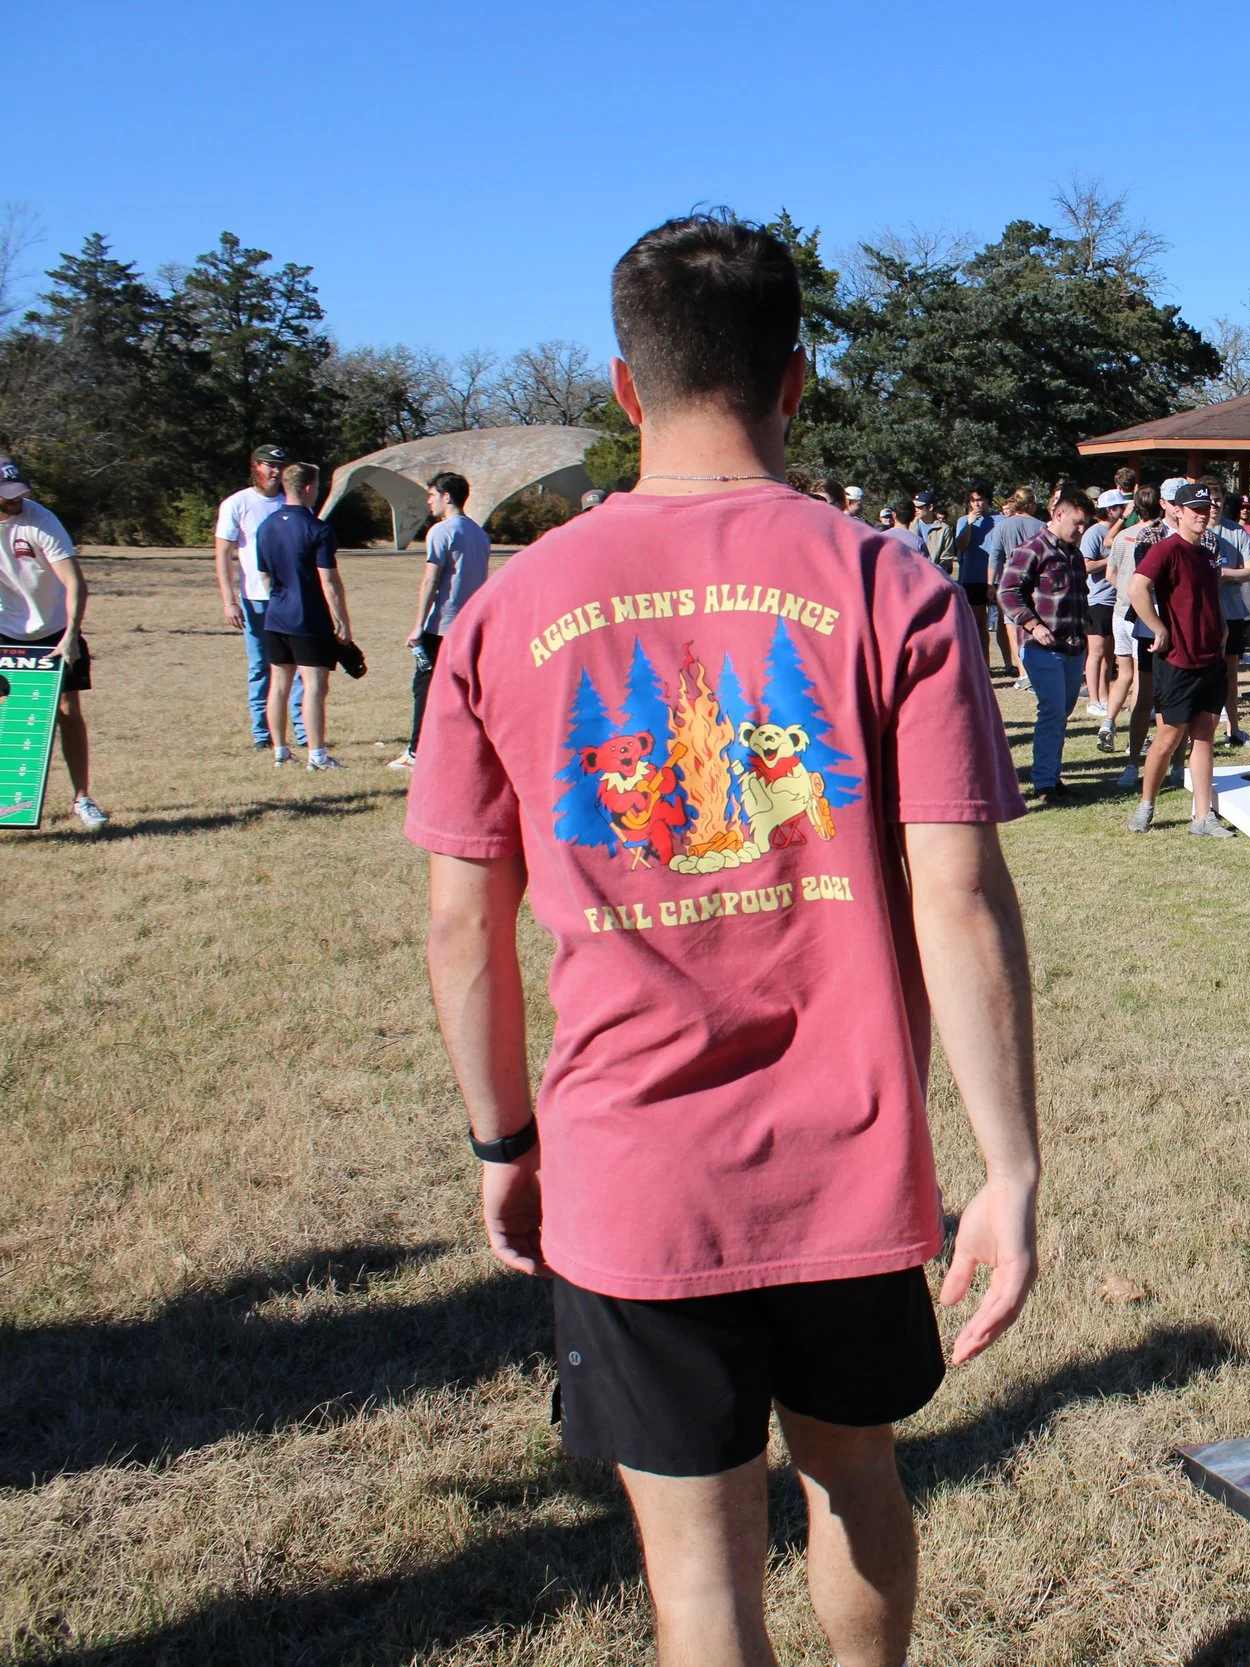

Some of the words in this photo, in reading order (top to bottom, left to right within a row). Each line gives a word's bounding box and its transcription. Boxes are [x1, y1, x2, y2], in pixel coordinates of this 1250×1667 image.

[529, 601, 609, 668] AGGIE
[610, 588, 695, 623] MEN'S
[704, 584, 840, 635] ALLIANCE
[584, 903, 653, 933] FALL
[659, 883, 793, 926] CAMPOUT
[801, 875, 854, 901] 2021
